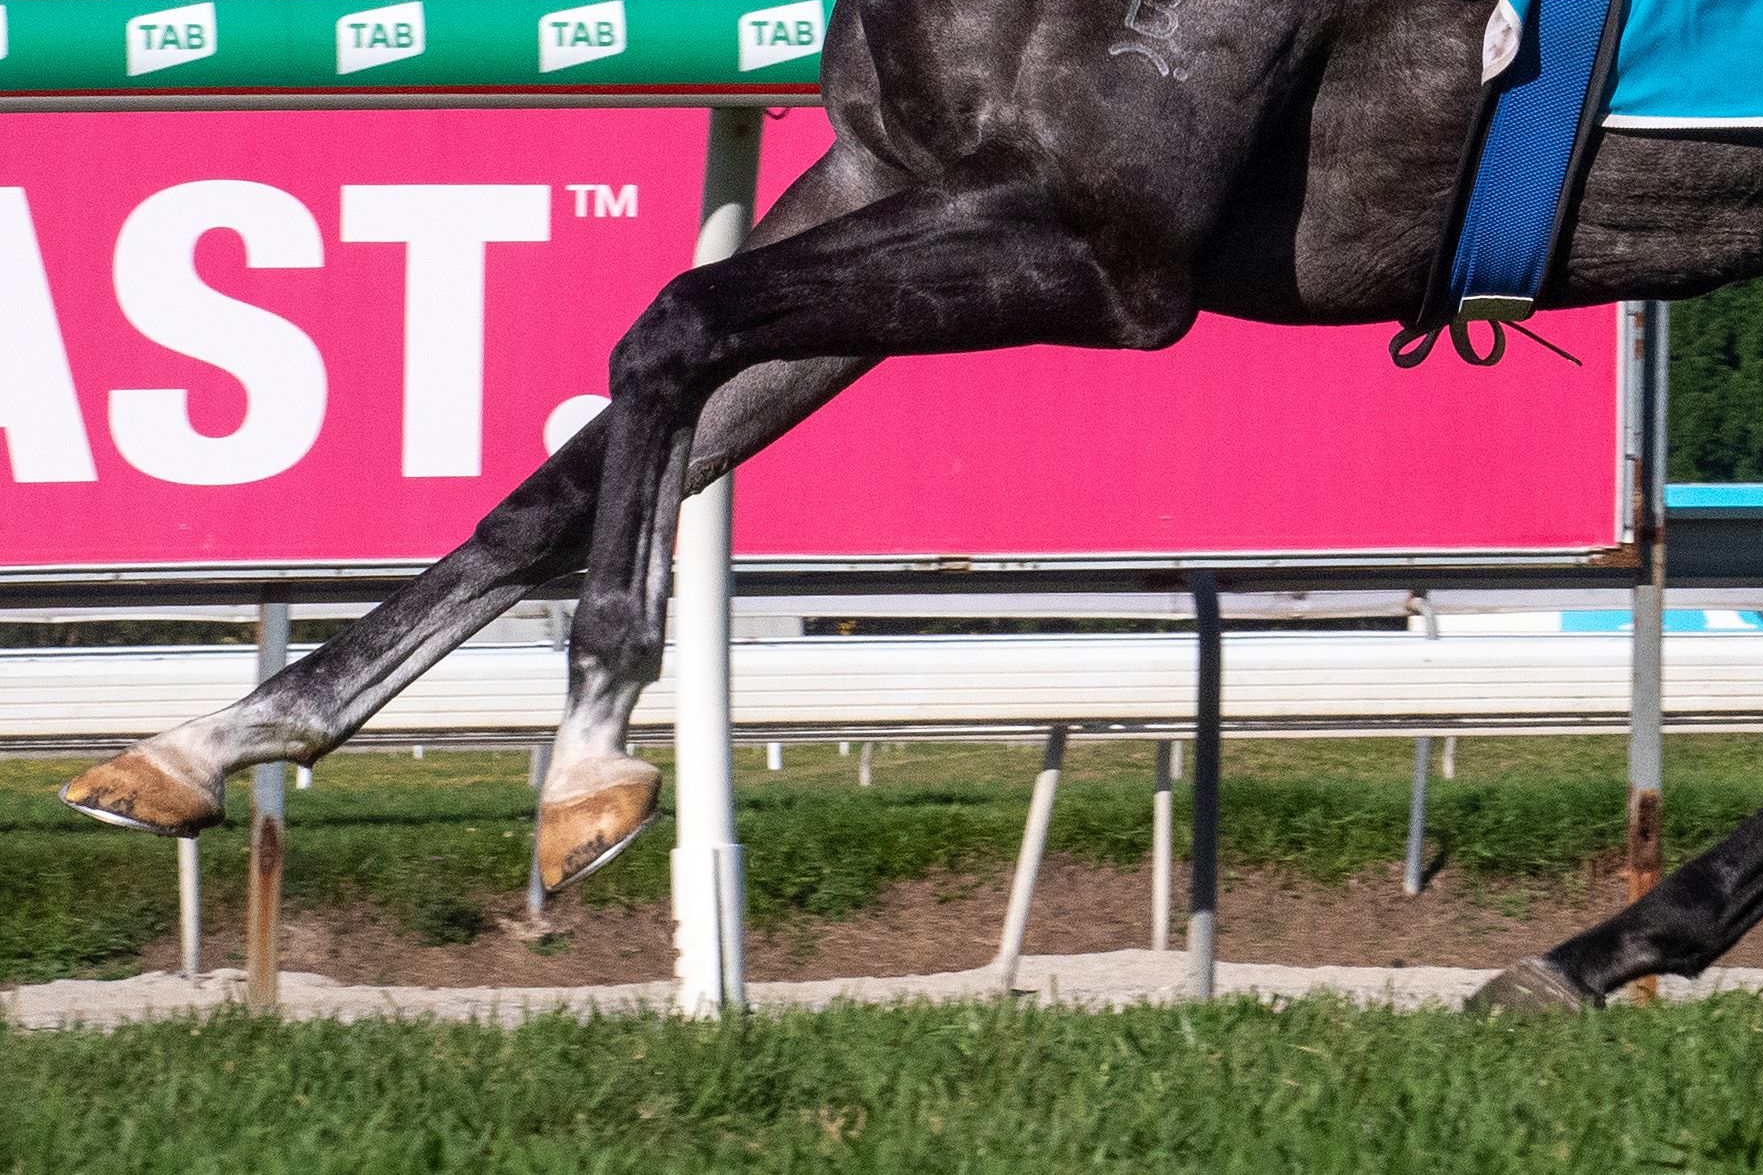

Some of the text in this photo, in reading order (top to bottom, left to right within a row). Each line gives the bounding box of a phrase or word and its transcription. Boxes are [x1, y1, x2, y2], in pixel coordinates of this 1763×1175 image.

[137, 23, 206, 50] TAB
[347, 22, 414, 49] TAB
[550, 21, 617, 47] TAB
[749, 20, 815, 46] TAB
